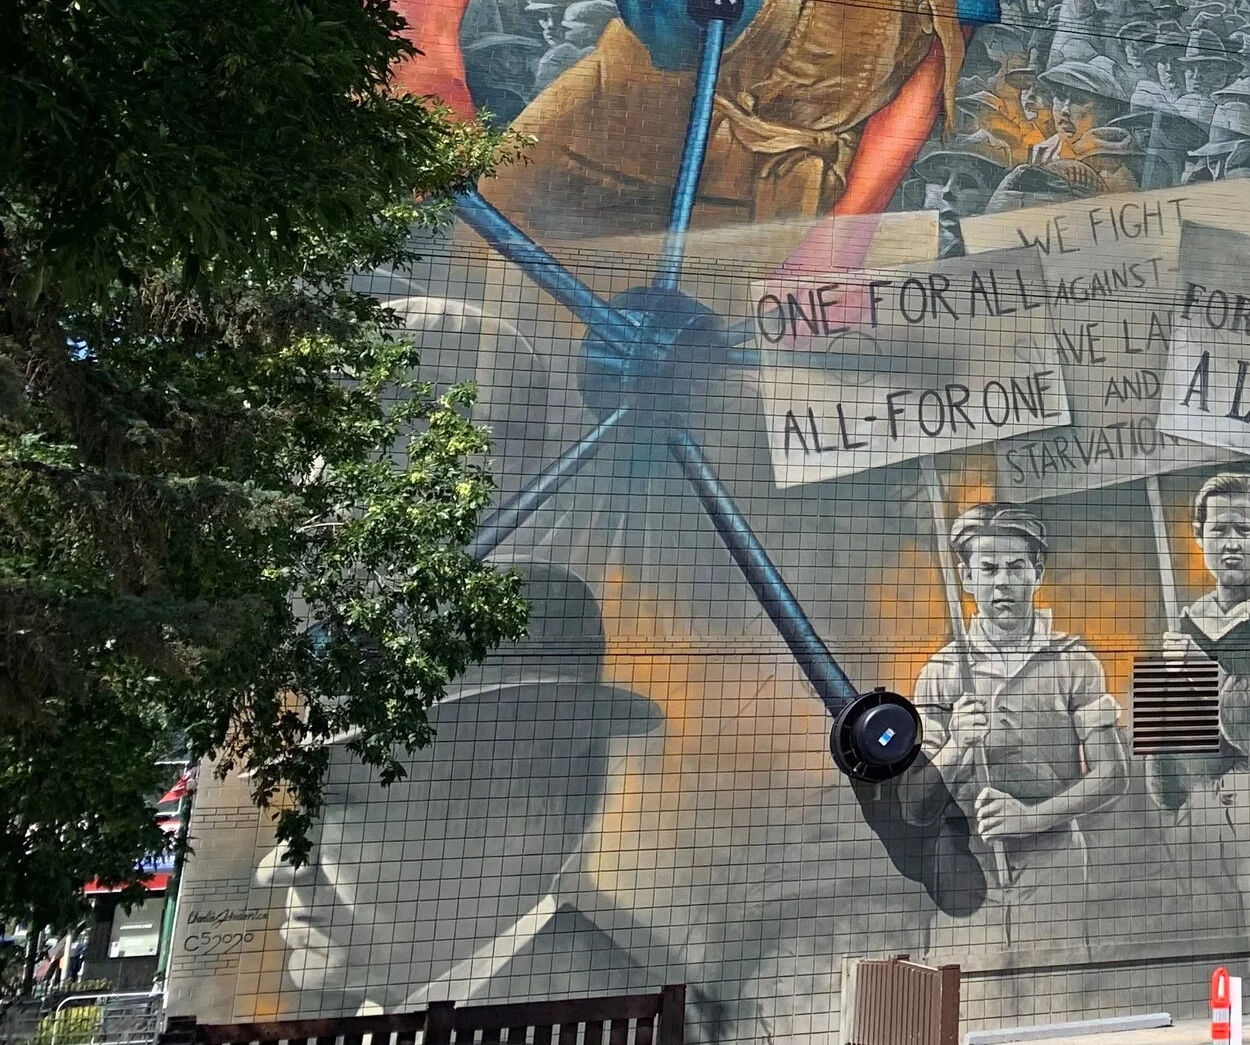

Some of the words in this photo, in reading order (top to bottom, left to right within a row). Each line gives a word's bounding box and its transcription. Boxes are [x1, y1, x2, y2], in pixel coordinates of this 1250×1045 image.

[1017, 214, 1080, 257] WE
[1088, 198, 1190, 247] FIGHT
[756, 284, 850, 344] ONE
[870, 273, 959, 329] FOR
[970, 268, 1043, 319] ALL
[983, 370, 1063, 427] ONE
[1104, 370, 1161, 408] AND
[1180, 350, 1211, 414] A
